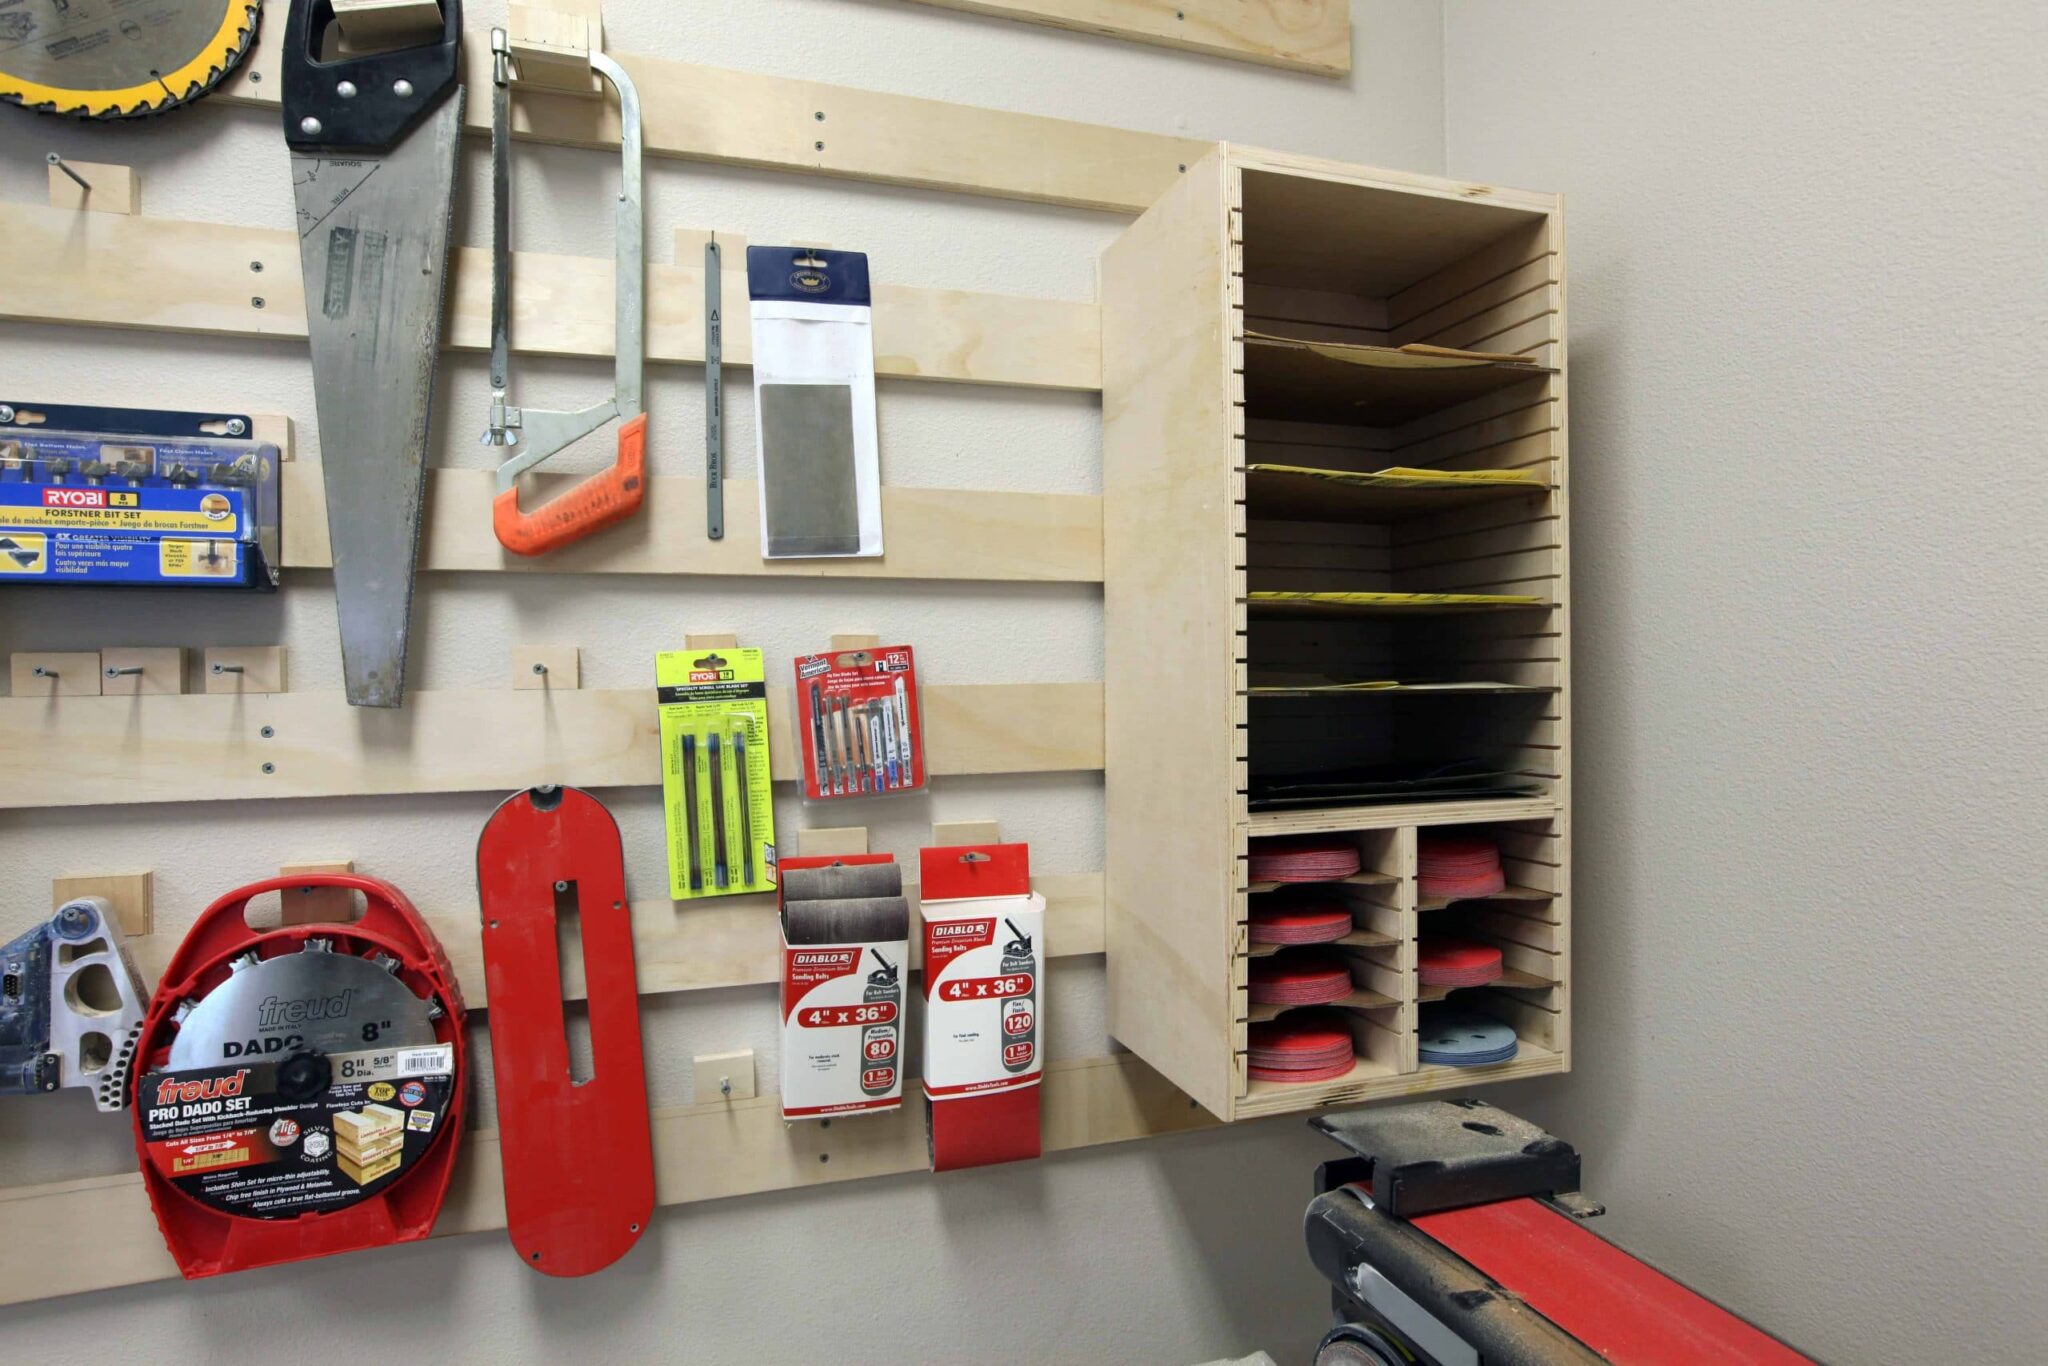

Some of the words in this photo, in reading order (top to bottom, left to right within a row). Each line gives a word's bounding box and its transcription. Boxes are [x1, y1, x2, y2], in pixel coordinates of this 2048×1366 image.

[47, 491, 102, 505] RYOBI
[45, 509, 101, 518] FORSTNER
[104, 510, 120, 518] BIT
[24, 516, 53, 525] mèches
[54, 518, 109, 527] emporte-pièce
[120, 520, 141, 529] Juego
[68, 550, 101, 558] supérieure
[112, 544, 133, 552] quatre
[55, 558, 76, 566] Cuatro
[96, 559, 108, 567] más
[110, 560, 129, 568] mayor
[55, 566, 88, 574] visibilidad
[800, 659, 826, 671] Vermont
[888, 654, 900, 665] 12
[691, 673, 717, 681] RYOBI
[801, 665, 831, 678] American
[935, 925, 974, 936] DIABLO
[931, 946, 953, 954] Sanding
[797, 954, 838, 964] DIABLO
[949, 982, 969, 998] 4"
[976, 984, 987, 996] x
[993, 977, 1024, 994] 36"
[259, 988, 351, 1026] freud
[809, 1009, 830, 1024] 4"
[837, 1012, 848, 1023] x
[855, 1005, 887, 1022] 36"
[1008, 1015, 1031, 1030] 120
[362, 1020, 391, 1042] 8"
[870, 1041, 891, 1056] 80
[1009, 1047, 1014, 1057] 1
[373, 1056, 395, 1065] 5/8"
[341, 1058, 365, 1078] 8"
[356, 1069, 374, 1077] Dia.
[868, 1072, 873, 1082] 1
[156, 1069, 245, 1105] freud
[965, 1081, 1008, 1091] www.DiabloTools.com
[149, 1106, 179, 1122] PRO
[182, 1101, 222, 1117] DADO
[225, 1096, 252, 1112] SET
[149, 1121, 174, 1130] Stacked
[217, 1108, 273, 1120] Kickback-Reducing
[303, 1126, 330, 1136] SILVER
[300, 1151, 333, 1163] COATING
[205, 1183, 230, 1192] Includes
[231, 1180, 246, 1188] Shim
[247, 1178, 257, 1187] Set
[266, 1173, 296, 1183] micro-thin
[297, 1168, 330, 1179] adjustability.
[225, 1193, 239, 1202] Chip
[240, 1191, 252, 1199] free
[252, 1188, 269, 1197] finish
[276, 1184, 300, 1194] Plywood
[306, 1180, 333, 1189] Melamine.
[252, 1200, 273, 1209] Always
[273, 1198, 287, 1206] cuts
[292, 1195, 304, 1203] true
[304, 1190, 341, 1200] flat-bottomed
[341, 1188, 361, 1197] groove.
